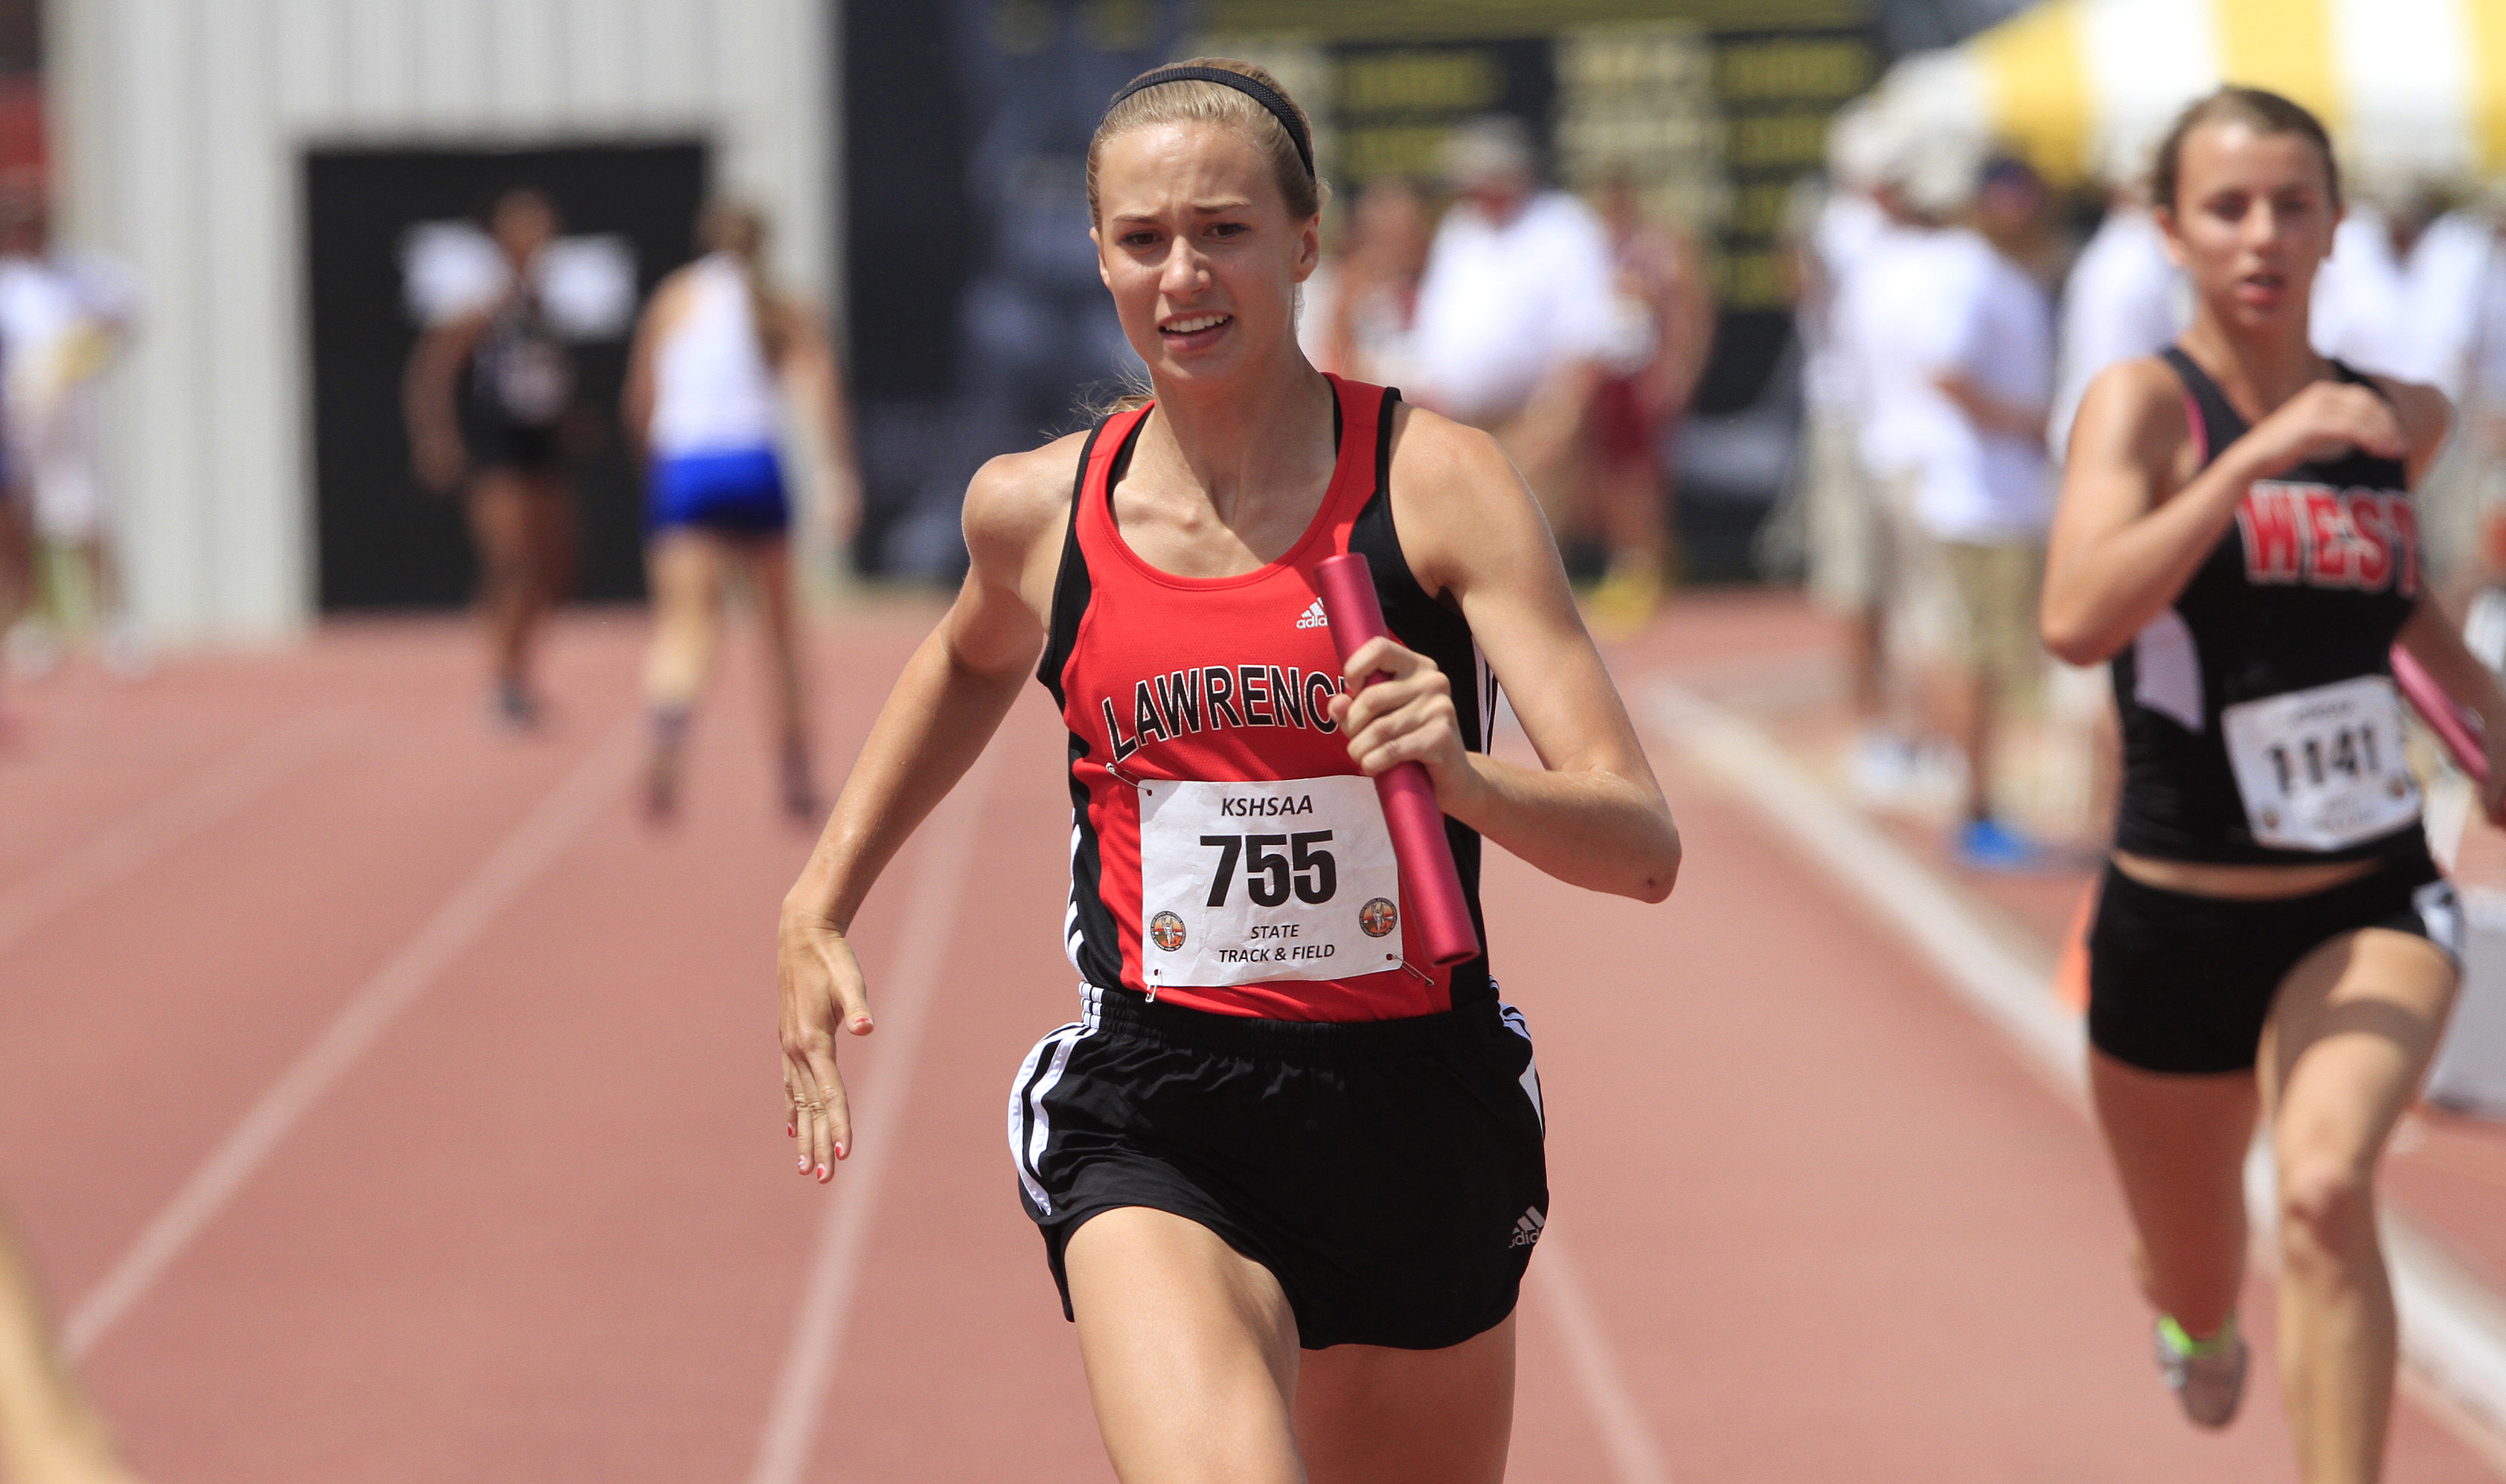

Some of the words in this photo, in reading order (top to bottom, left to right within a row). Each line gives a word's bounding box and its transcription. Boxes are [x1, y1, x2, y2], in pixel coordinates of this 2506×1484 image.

[2235, 479, 2424, 596] WEST
[1296, 614, 1328, 630] adid
[1102, 665, 1348, 764] LAWRENC
[2267, 723, 2380, 794] 1141
[1221, 794, 1314, 817] KSHSAA
[1200, 829, 1338, 908] 755
[1251, 924, 1300, 940] STATE
[1219, 948, 1271, 963] TRACK
[1274, 947, 1287, 961] &
[1292, 944, 1335, 960] FIELD
[1508, 1228, 1540, 1249] did
